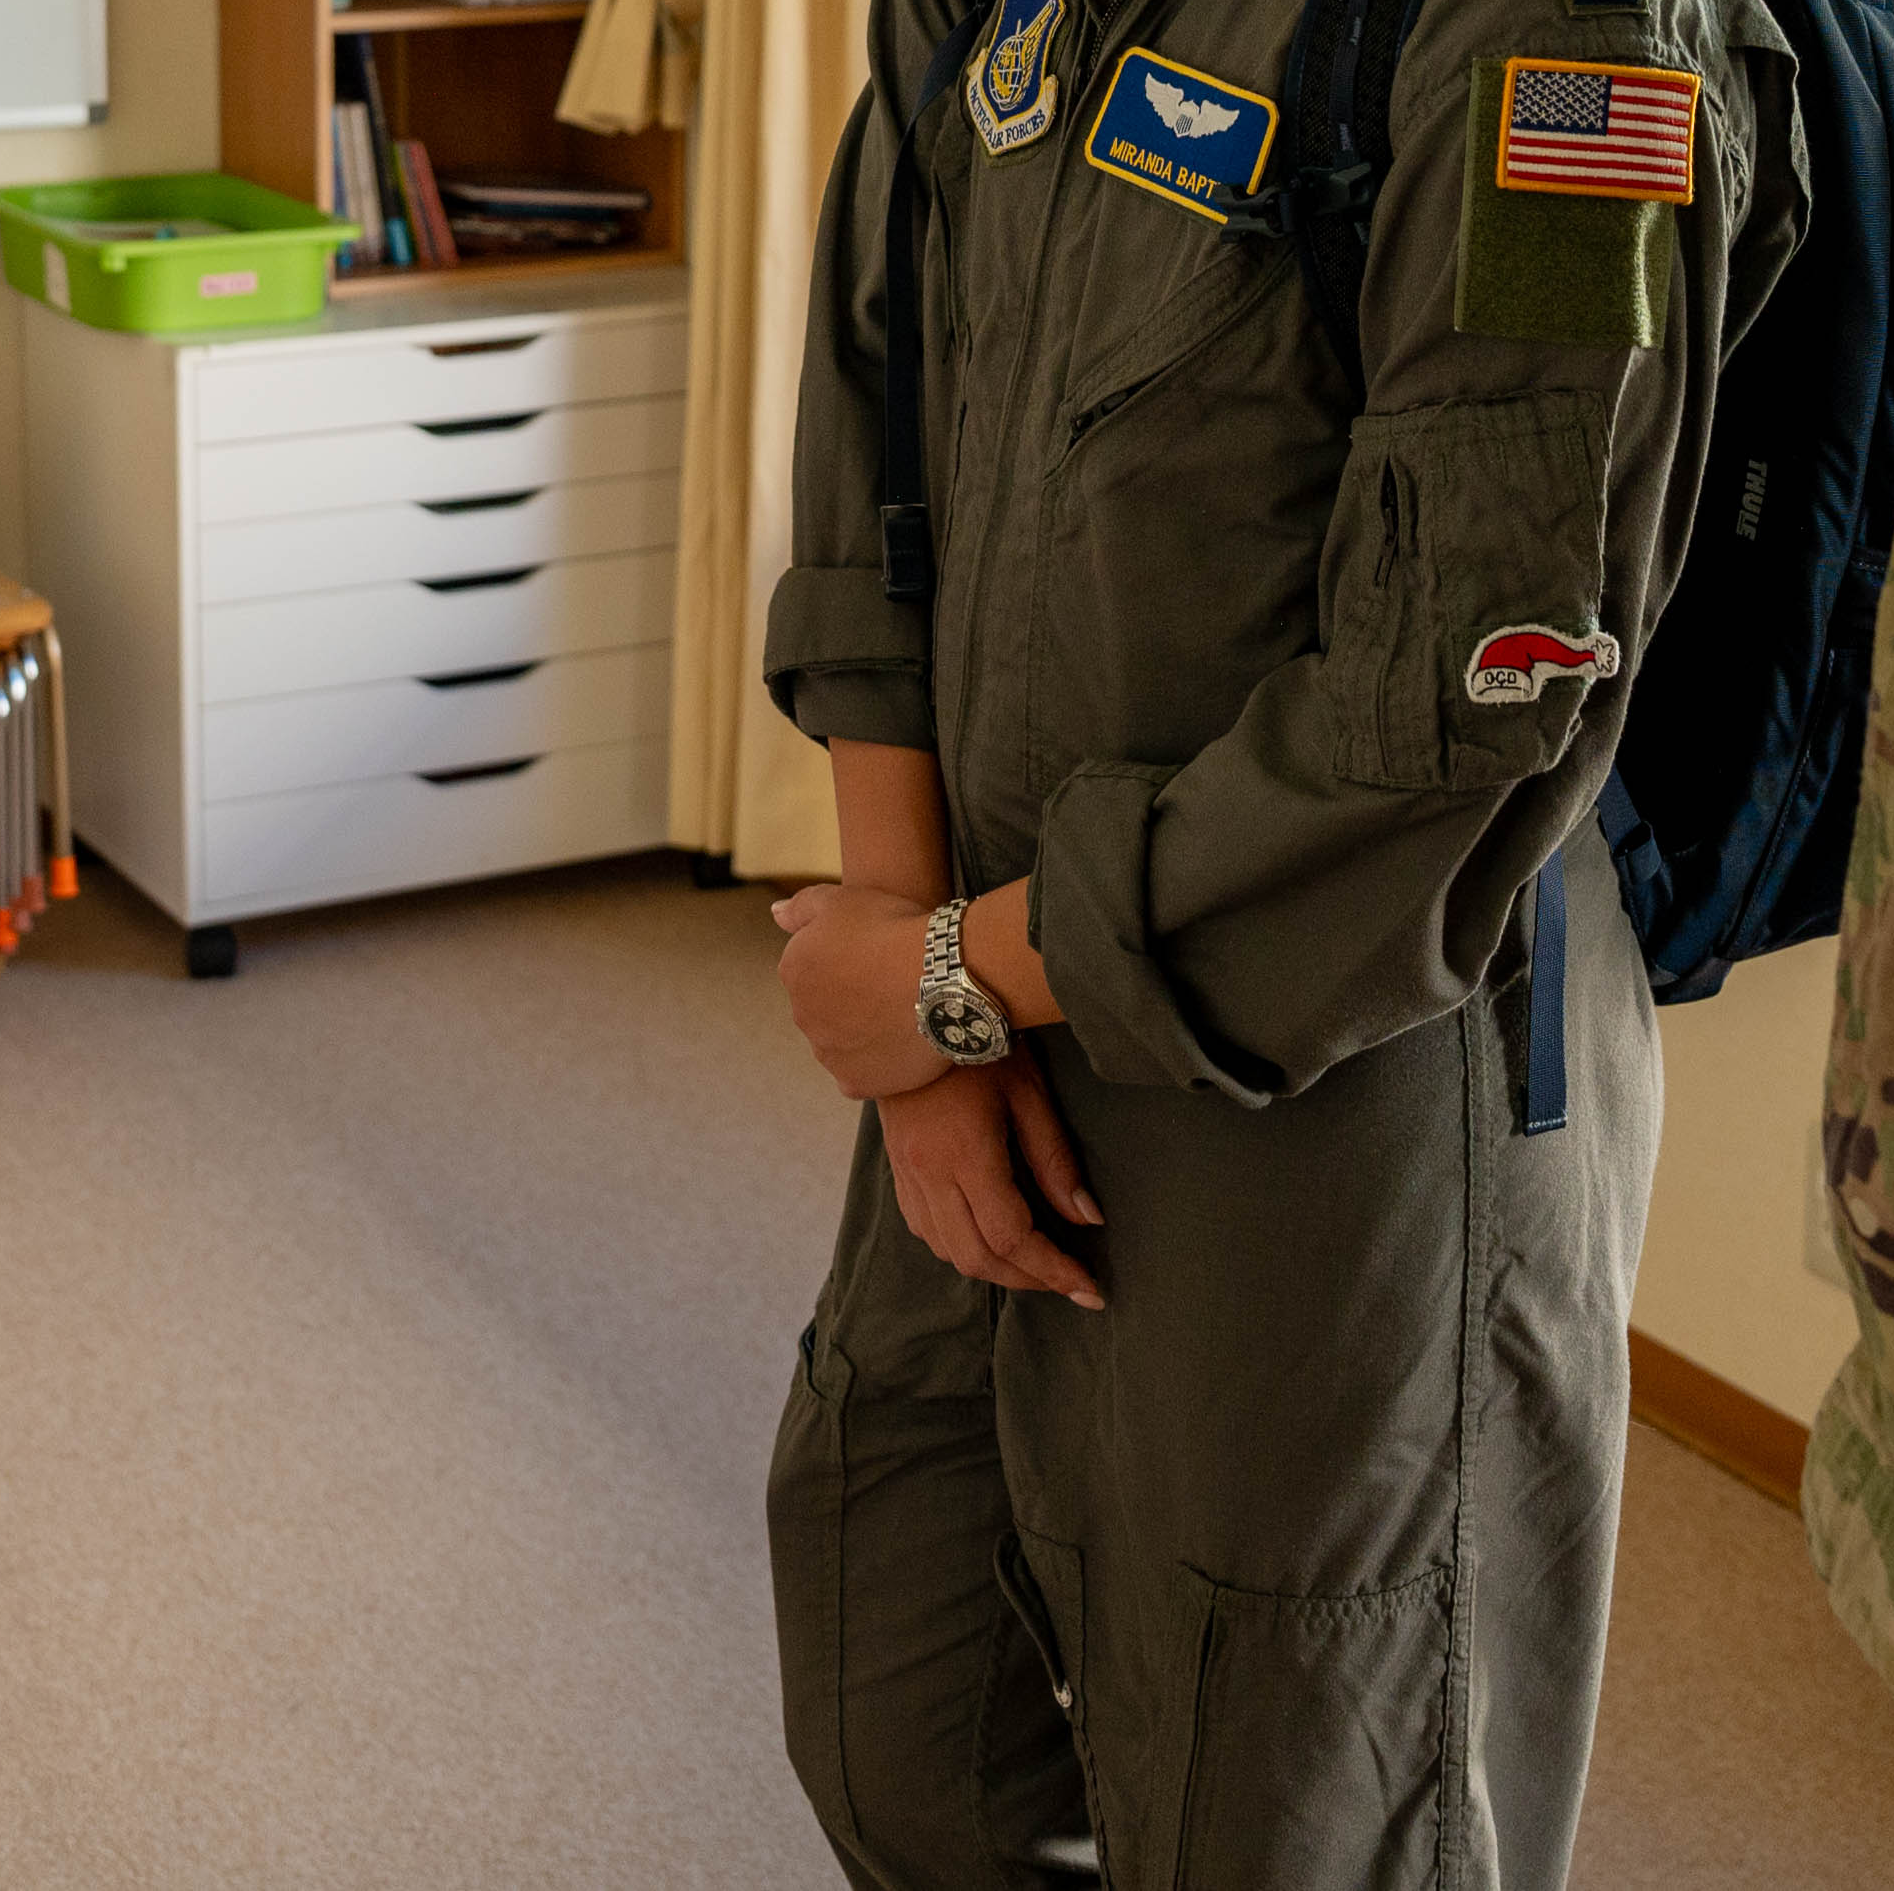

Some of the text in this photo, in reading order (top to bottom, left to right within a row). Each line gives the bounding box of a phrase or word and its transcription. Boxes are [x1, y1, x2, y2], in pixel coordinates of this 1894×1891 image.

[968, 82, 998, 131] PACIFIC
[1005, 109, 1048, 143] FORCES
[1109, 136, 1221, 200] MIRANDA BAPT
[1736, 459, 1768, 541] THULE
